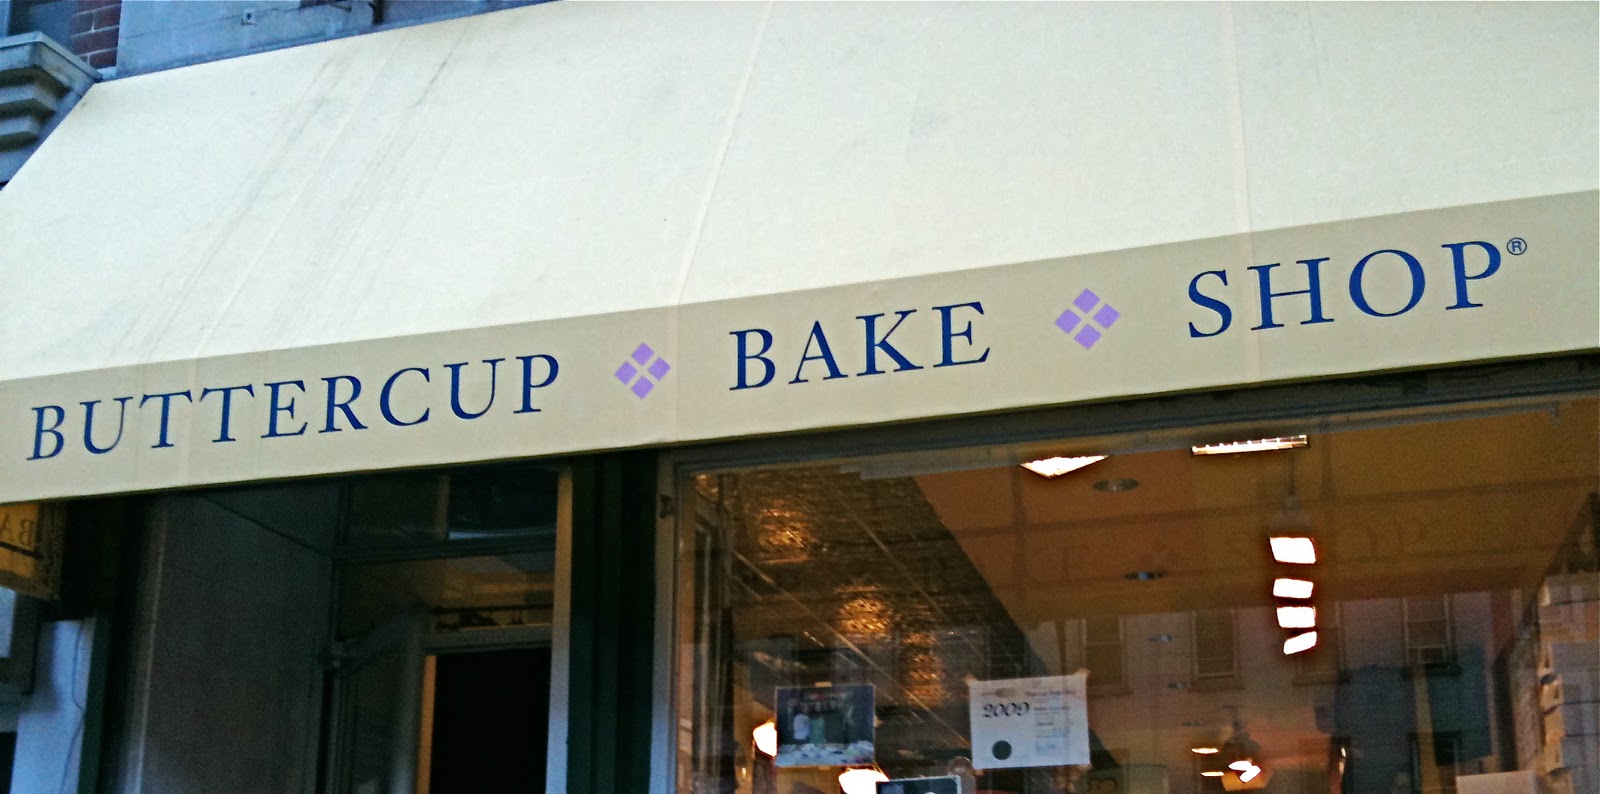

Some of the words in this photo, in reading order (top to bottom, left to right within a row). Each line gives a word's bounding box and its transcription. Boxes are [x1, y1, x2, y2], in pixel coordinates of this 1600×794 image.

[27, 353, 561, 461] BUTTERCUP
[729, 301, 990, 391] BAKE
[982, 701, 1031, 718] 2009
